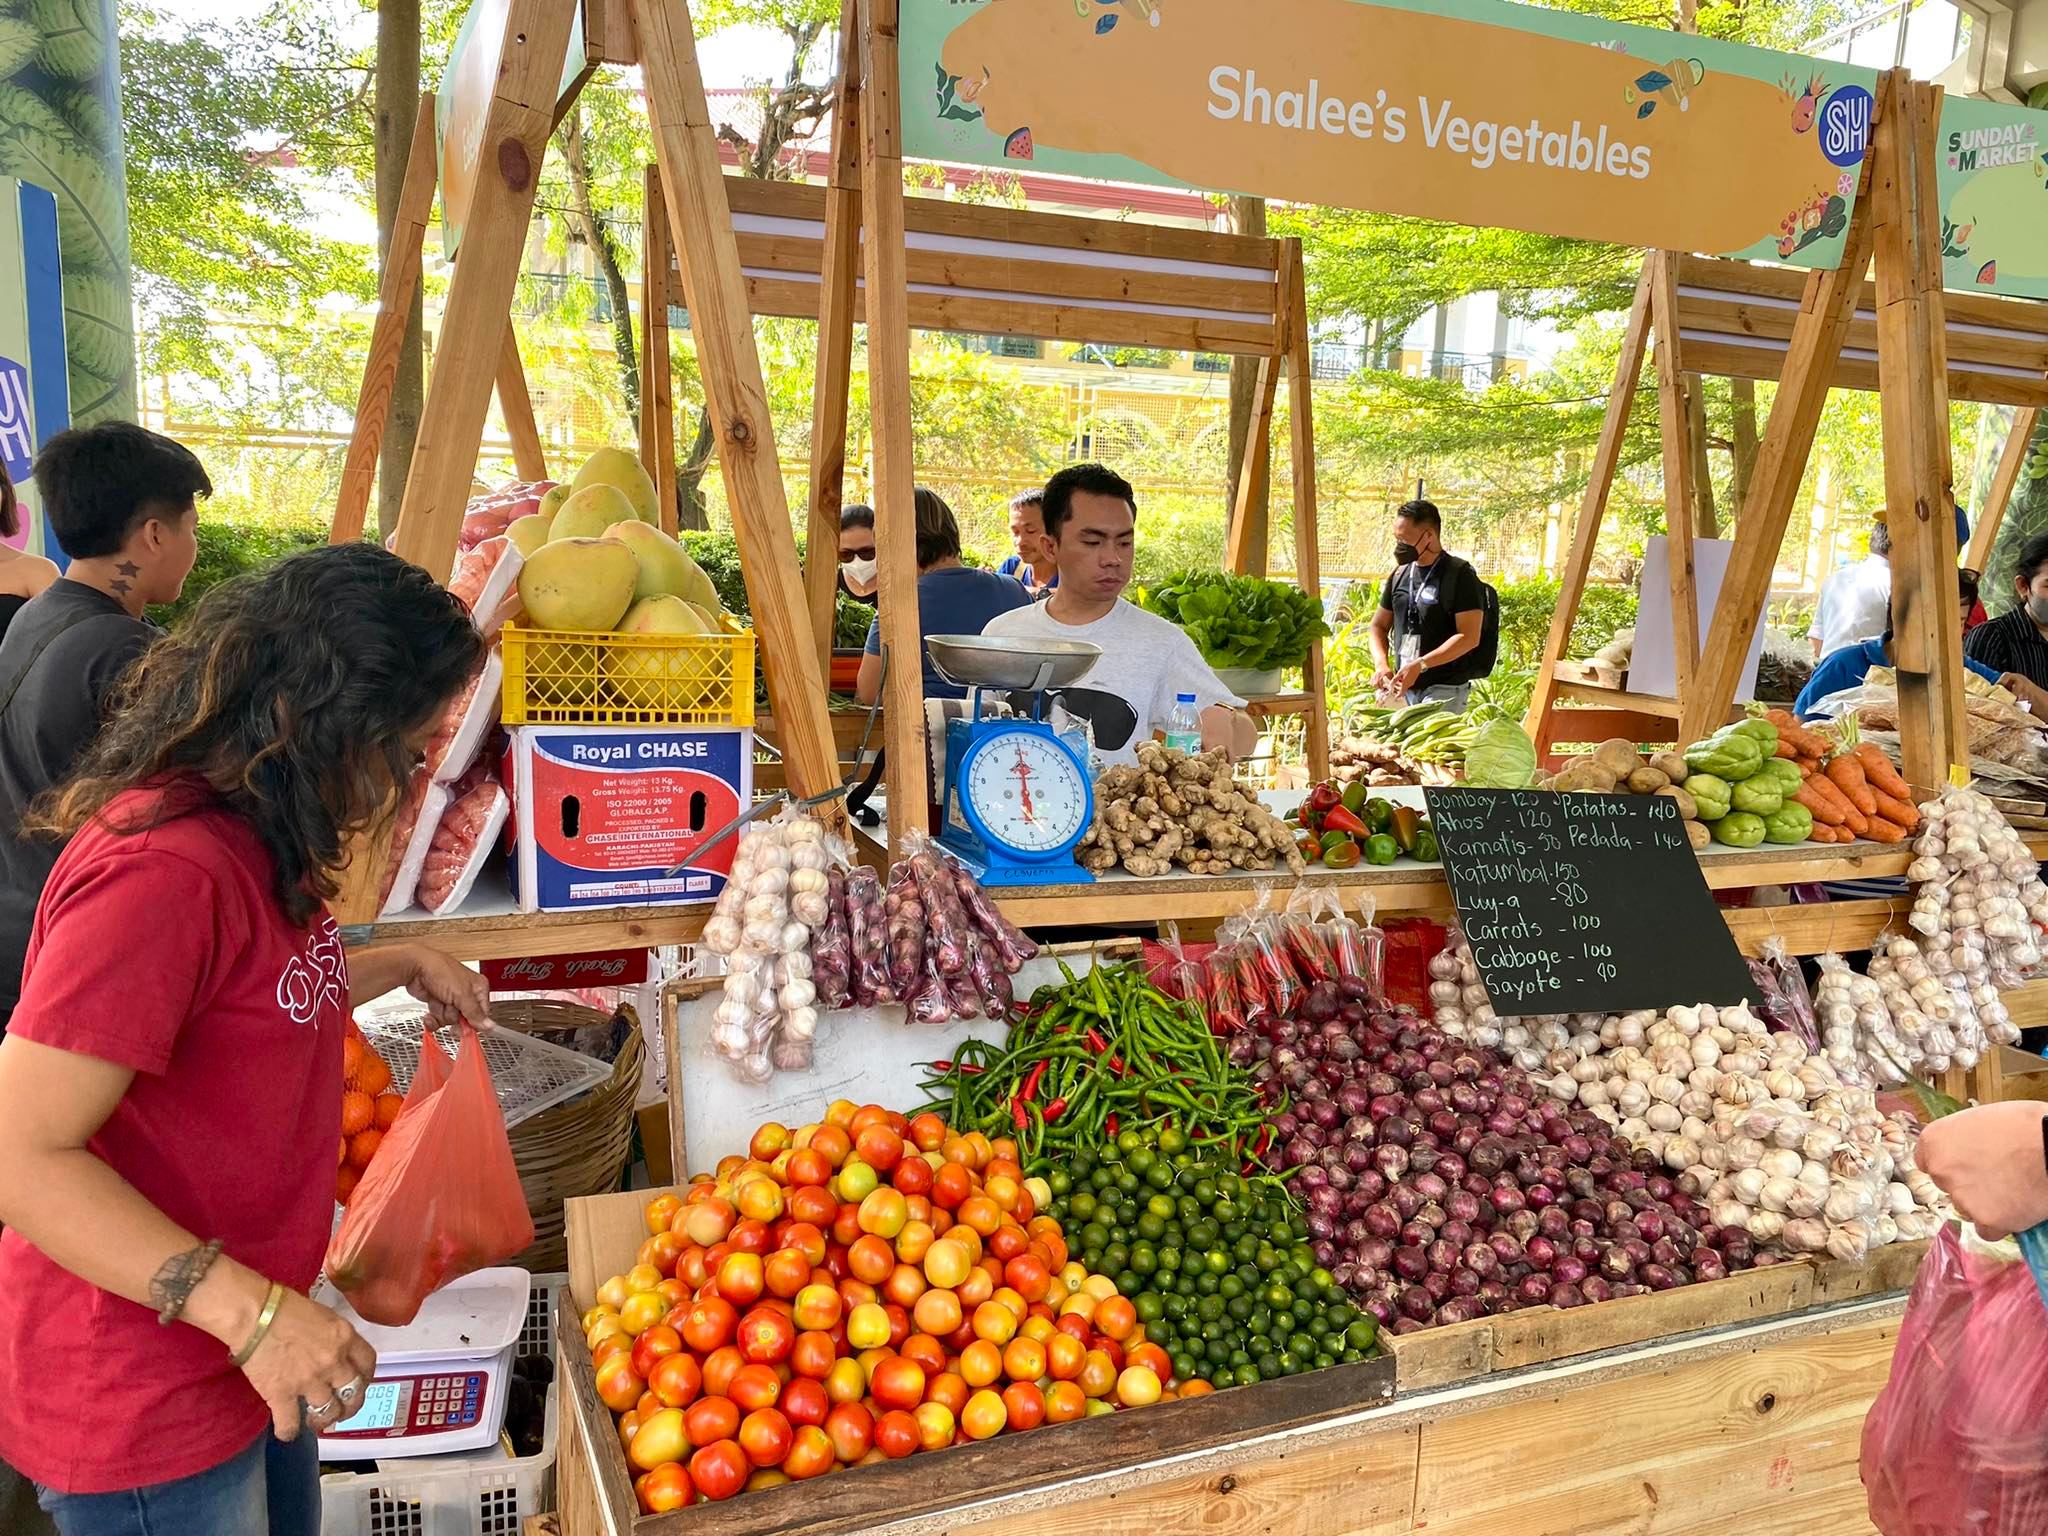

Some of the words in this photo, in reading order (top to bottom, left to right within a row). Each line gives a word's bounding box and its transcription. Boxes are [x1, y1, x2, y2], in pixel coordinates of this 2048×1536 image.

[1207, 64, 1407, 144] Shalee's
[1417, 95, 1652, 180] Vegetables
[1826, 96, 1868, 156] SM
[1948, 123, 2027, 152] SUNDAY
[1958, 142, 2040, 172] MARKET
[572, 743, 631, 763] Royal
[637, 741, 708, 758] CHASE
[592, 788, 616, 796] Gross
[651, 785, 671, 794] 13.75
[603, 779, 617, 787] Net
[606, 800, 621, 808] ISO
[653, 797, 672, 806] 2005
[1427, 789, 1497, 820] Bombay
[1562, 794, 1627, 820] Patatas
[1518, 809, 1551, 829] 120
[587, 833, 618, 842] CHASE
[620, 830, 692, 841] INTERNATIONAL
[1465, 912, 1543, 942] Carrots
[1572, 915, 1601, 930] 100
[565, 958, 627, 978] Fresh
[1475, 945, 1562, 973] Cabbage
[1583, 943, 1612, 958] 100
[1485, 969, 1561, 1001] Sayote
